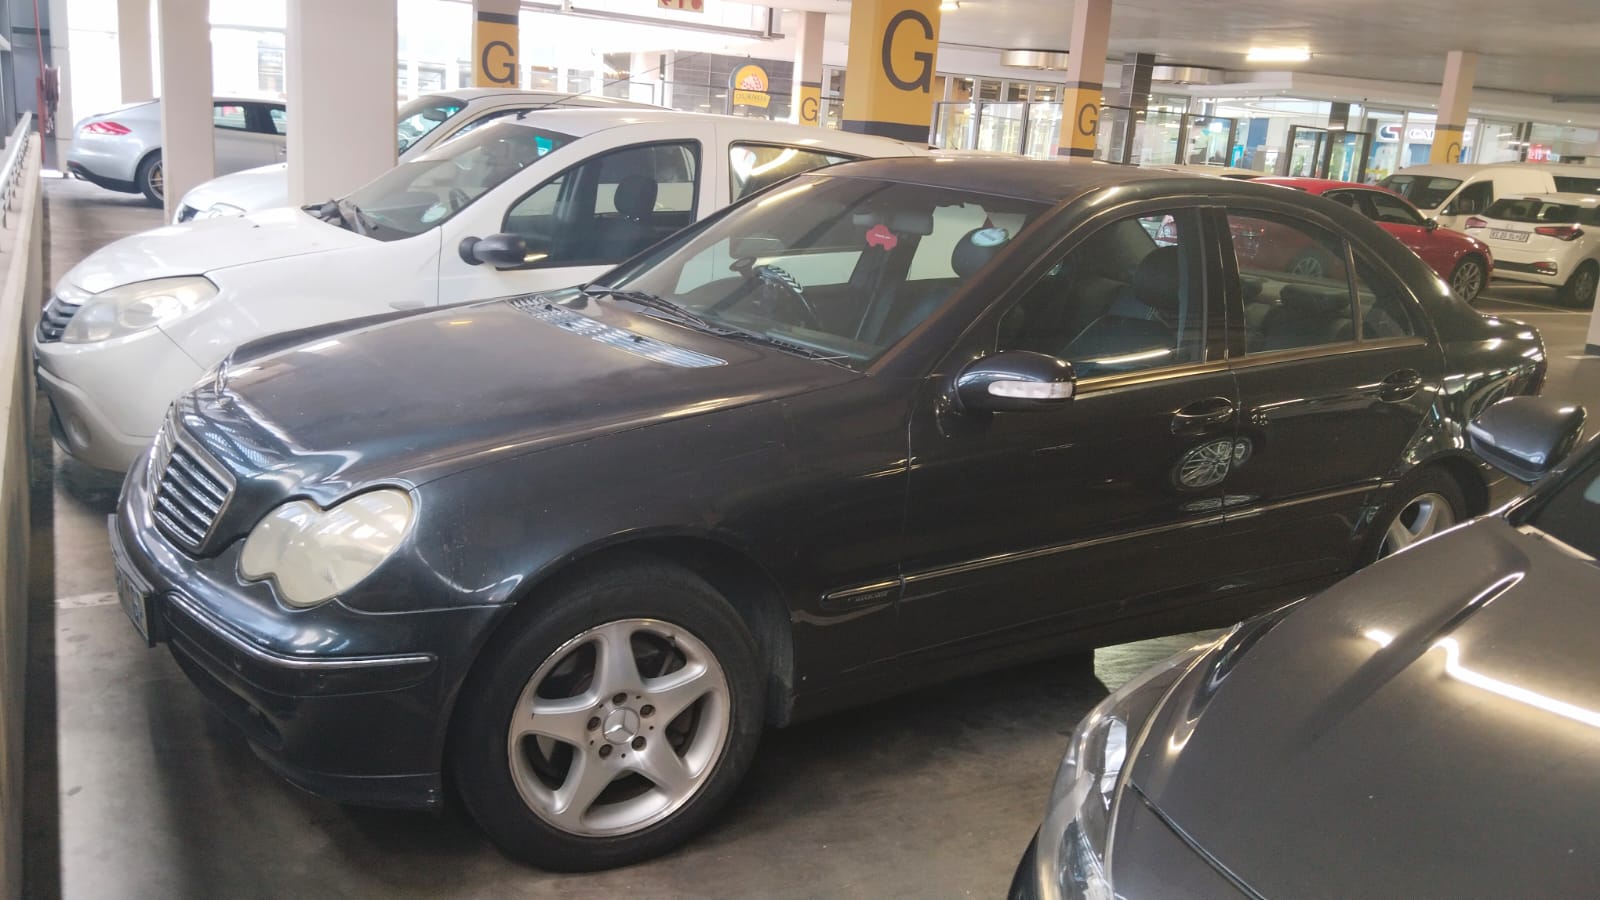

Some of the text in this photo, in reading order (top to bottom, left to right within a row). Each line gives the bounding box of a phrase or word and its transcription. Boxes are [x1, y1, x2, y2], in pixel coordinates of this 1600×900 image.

[482, 40, 515, 85] G
[881, 9, 934, 94] G
[801, 96, 818, 122] G
[1078, 103, 1098, 137] G
